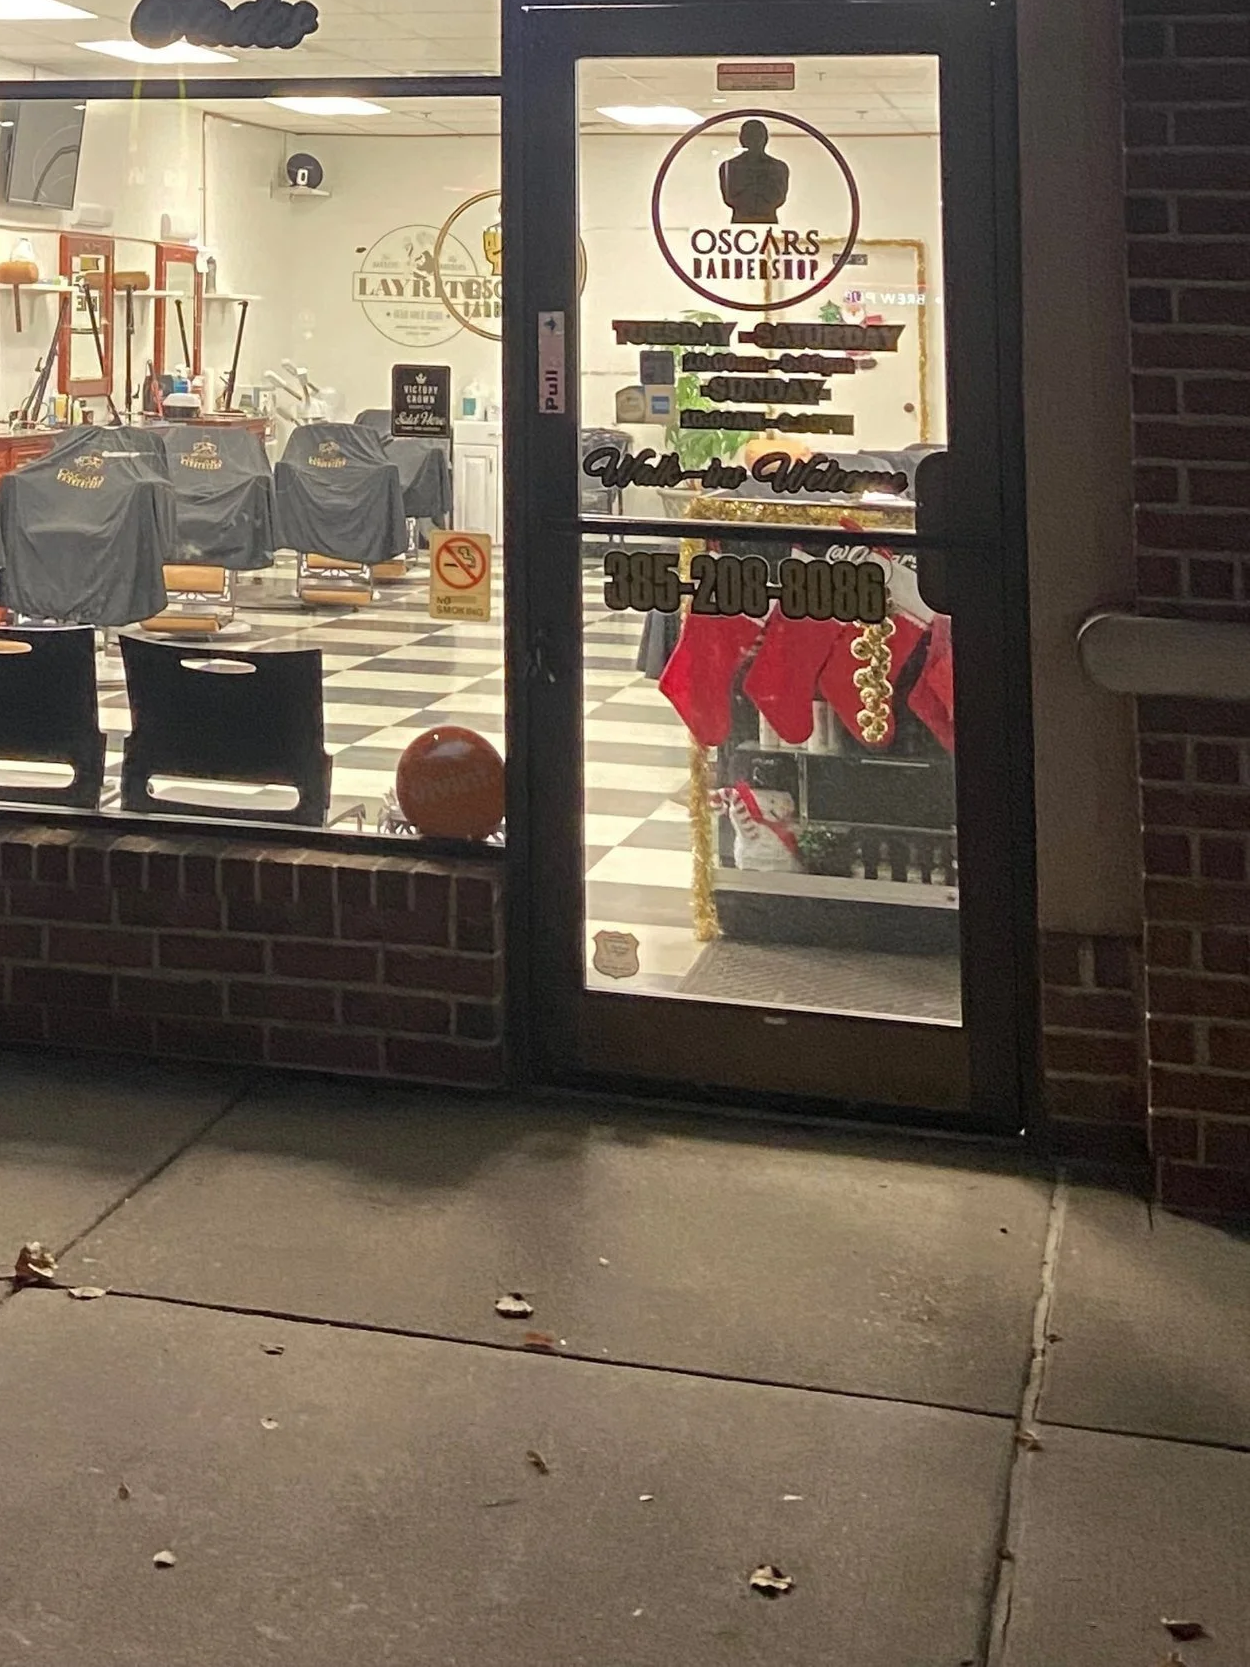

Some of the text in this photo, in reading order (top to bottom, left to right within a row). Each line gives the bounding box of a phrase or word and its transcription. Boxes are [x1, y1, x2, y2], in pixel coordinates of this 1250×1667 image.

[691, 226, 820, 256] OSCARS
[693, 257, 819, 281] BARBERSHOP
[545, 370, 559, 411] Pull
[436, 595, 452, 604] NO
[603, 550, 886, 624] 385-208-8086
[436, 605, 484, 617] SMOKING
